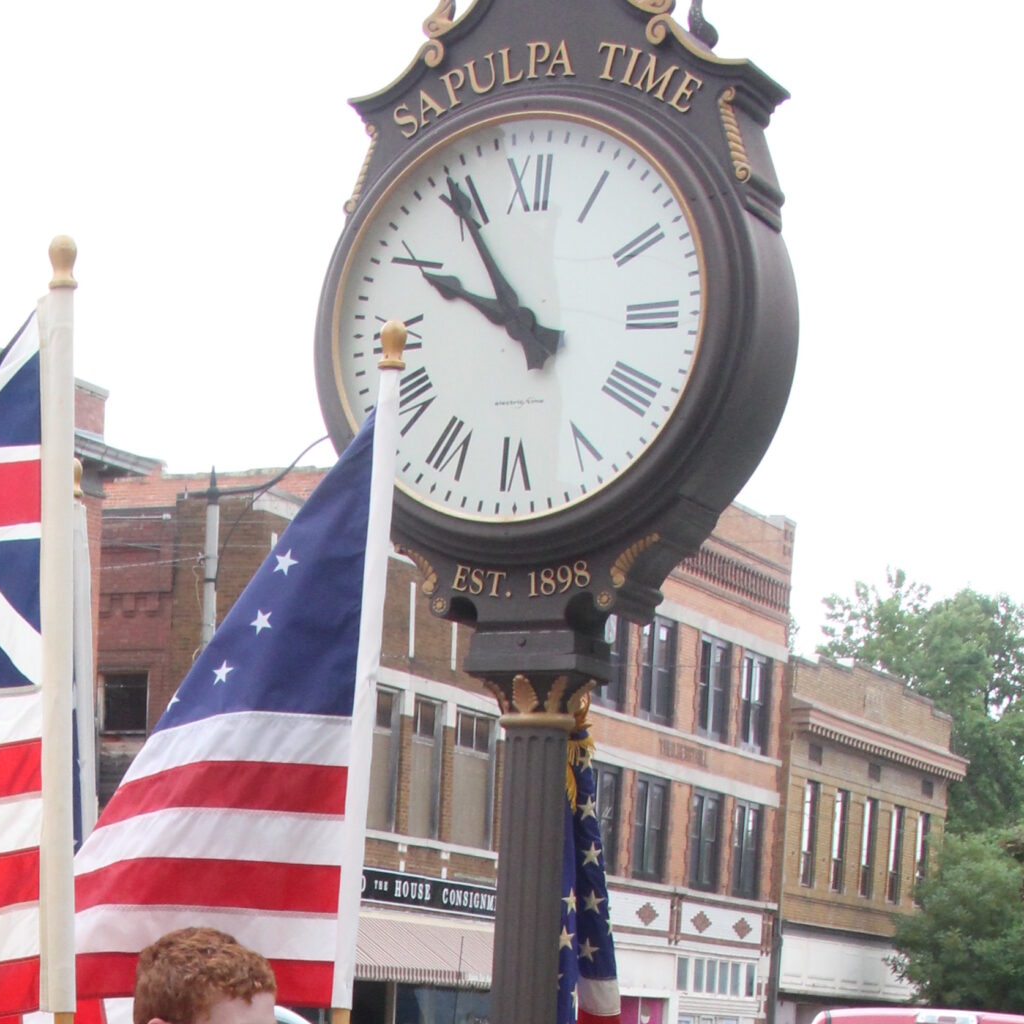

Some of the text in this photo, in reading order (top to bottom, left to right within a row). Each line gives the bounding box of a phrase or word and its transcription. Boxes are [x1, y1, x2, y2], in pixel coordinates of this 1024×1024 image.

[392, 39, 703, 139] SAPULPA TIME
[451, 560, 592, 598] EST. 1898
[374, 879, 388, 891] THE
[394, 879, 431, 901] HOUSE
[442, 888, 497, 911] CONSIGNM
